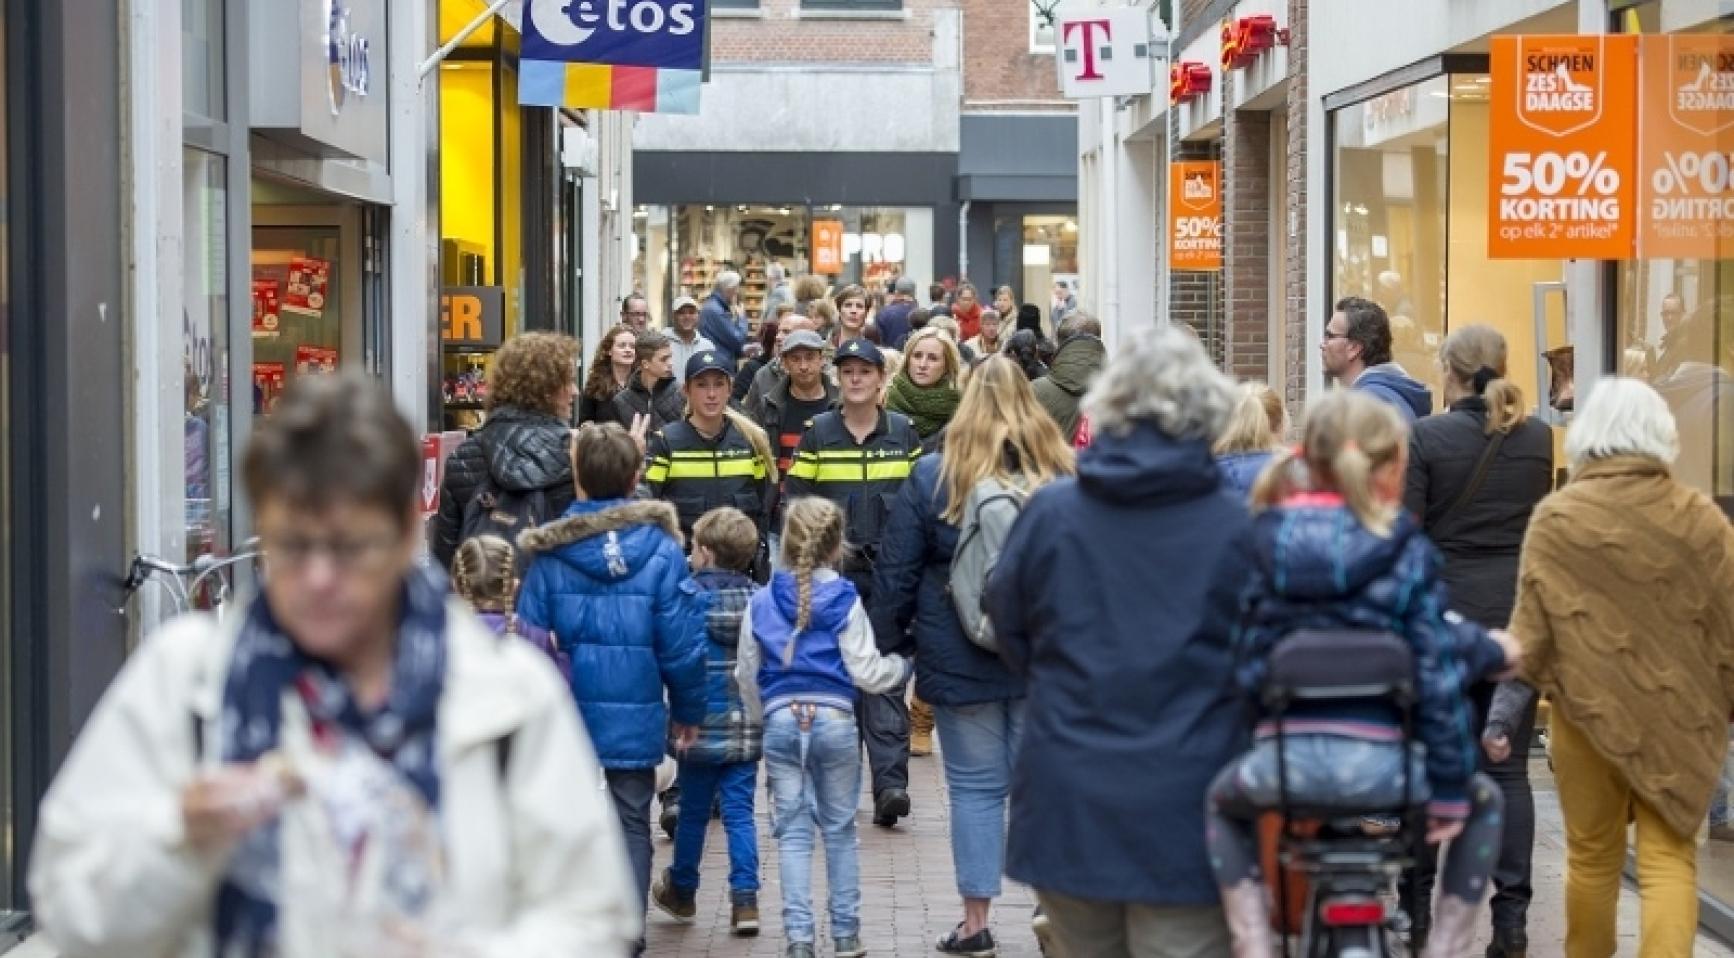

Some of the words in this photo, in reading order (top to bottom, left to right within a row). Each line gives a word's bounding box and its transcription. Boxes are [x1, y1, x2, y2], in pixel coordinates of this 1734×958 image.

[569, 0, 695, 35] etos
[1063, 19, 1111, 81] T
[1527, 55, 1594, 72] SCHOEN
[1526, 73, 1557, 92] ZES
[1526, 92, 1594, 111] DAAGSE
[1501, 152, 1620, 195] 50%
[1500, 198, 1620, 220] KORTING
[1500, 226, 1521, 241] op
